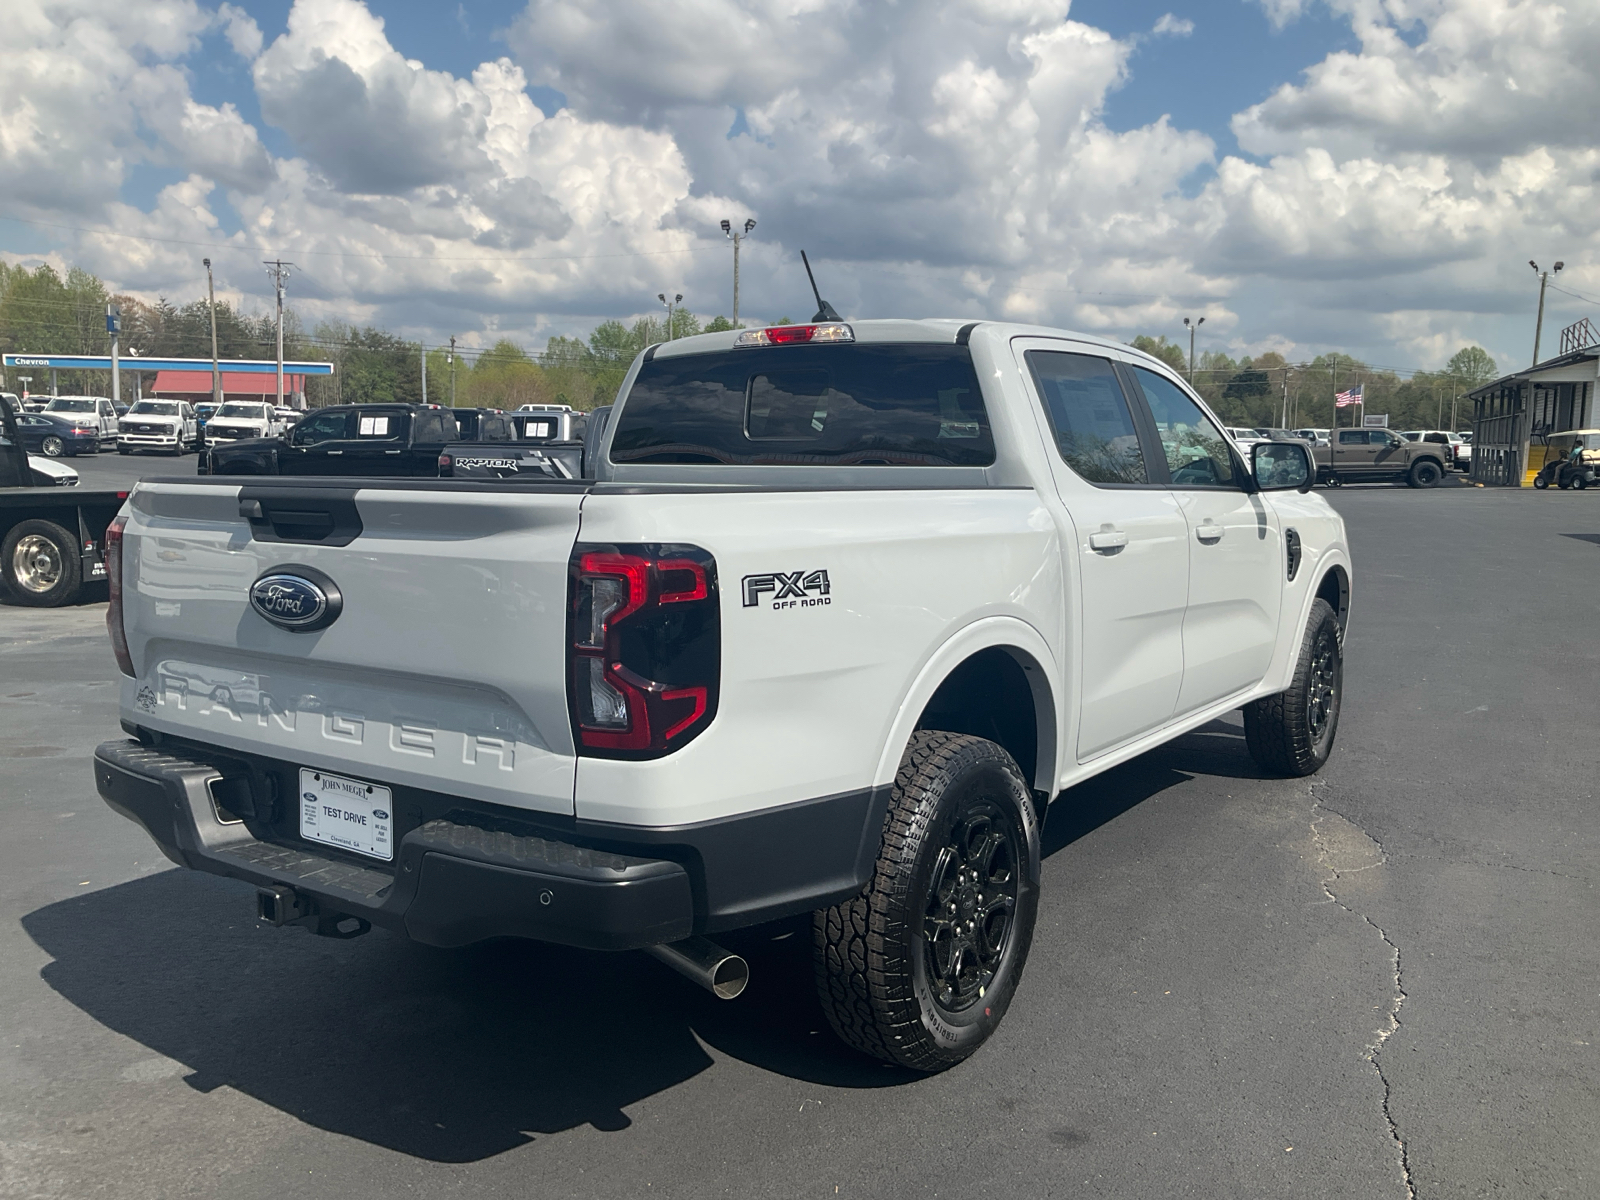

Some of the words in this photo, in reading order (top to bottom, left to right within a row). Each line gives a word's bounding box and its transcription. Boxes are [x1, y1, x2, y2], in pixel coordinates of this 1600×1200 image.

[15, 358, 49, 366] Chevron
[456, 458, 518, 471] RAPTOR
[741, 570, 830, 607] FX4
[265, 585, 304, 614] Ford
[773, 602, 797, 610] OFF
[801, 598, 831, 607] ROAD
[157, 673, 516, 771] RANGER
[321, 778, 341, 791] JOHN
[342, 783, 368, 800] MEGEL
[323, 806, 342, 819] TEST
[344, 811, 367, 825] DRIVE
[331, 835, 353, 846] Cleveland,
[926, 1007, 958, 1042] TERRITORY
